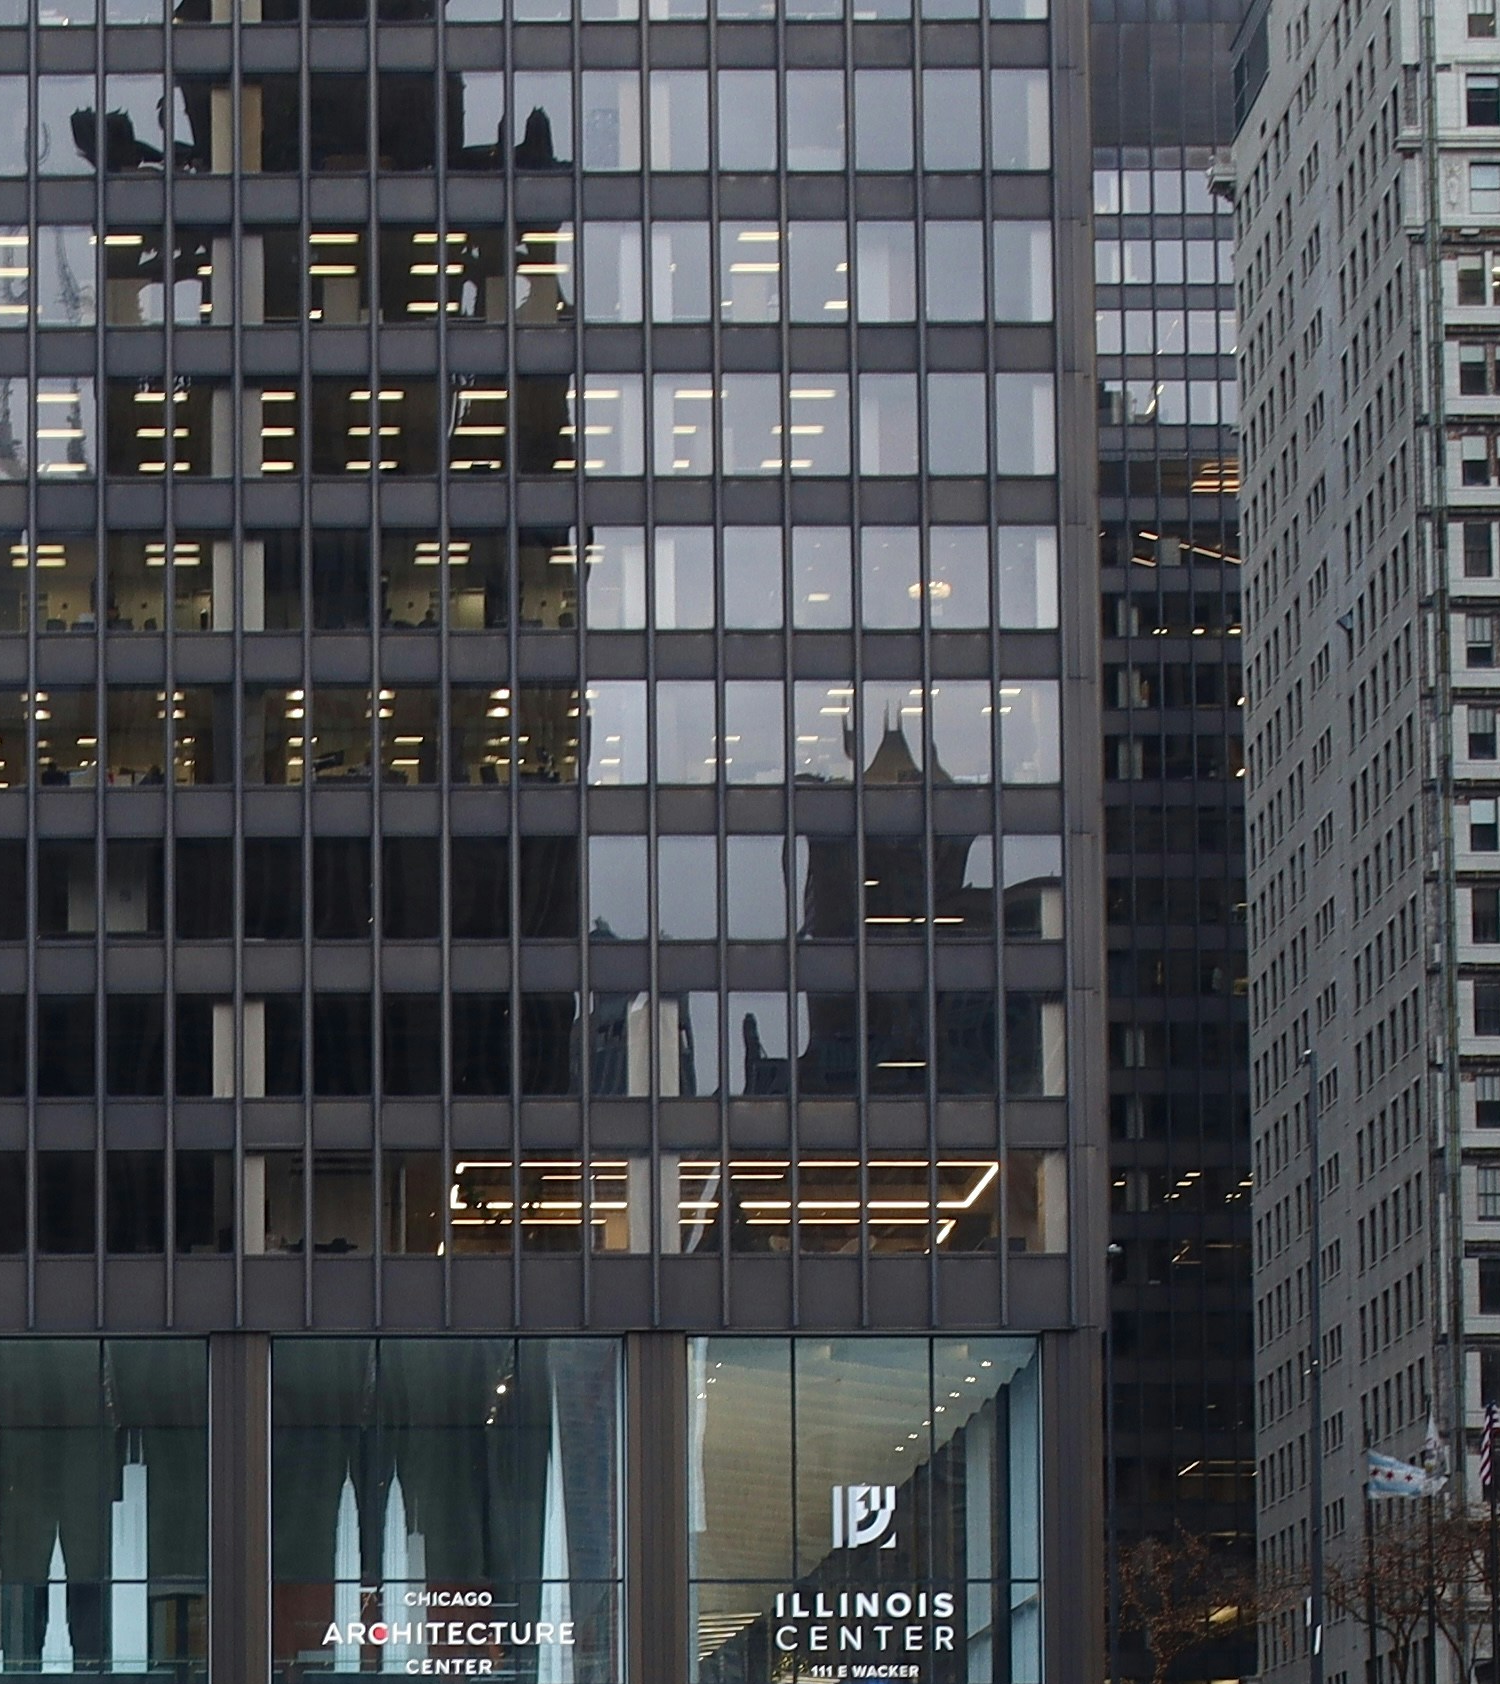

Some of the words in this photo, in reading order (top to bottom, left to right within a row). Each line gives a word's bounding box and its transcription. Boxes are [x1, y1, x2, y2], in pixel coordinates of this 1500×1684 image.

[404, 1591, 493, 1607] CHICAGO
[775, 1592, 955, 1618] ILLINOIS
[322, 1622, 576, 1645] ARCHITECTURE
[775, 1625, 955, 1651] CENTER
[405, 1658, 493, 1675] CENTER
[811, 1665, 833, 1678] 111
[838, 1665, 848, 1678] E
[851, 1665, 920, 1678] WACKER
